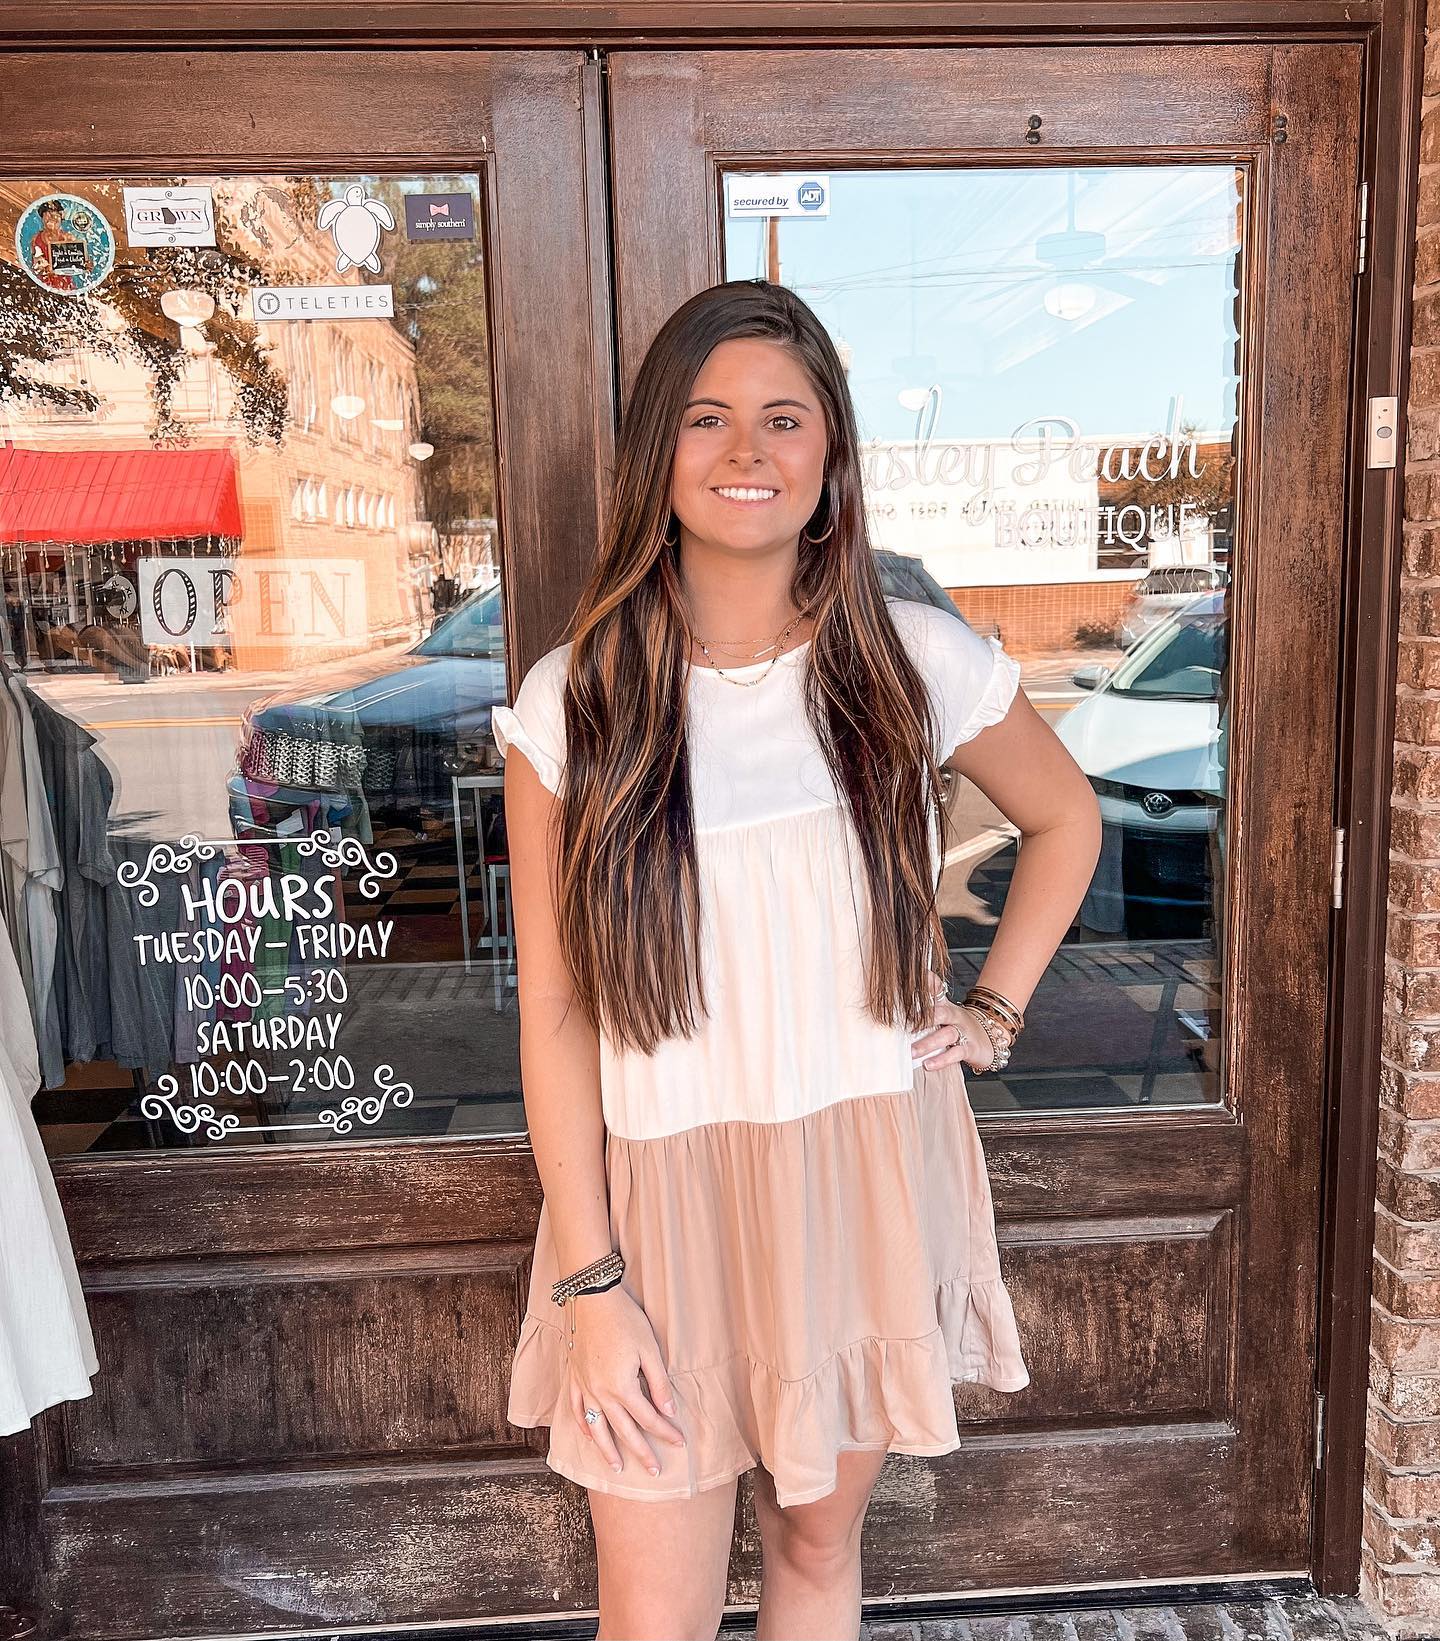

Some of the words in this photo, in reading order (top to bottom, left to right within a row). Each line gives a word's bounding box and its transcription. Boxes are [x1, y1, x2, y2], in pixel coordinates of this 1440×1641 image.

[733, 197, 775, 206] secured
[776, 196, 789, 207] by
[802, 189, 821, 203] ADT
[415, 218, 437, 232] simply
[437, 217, 466, 228] southern
[286, 295, 389, 310] TELETIES
[1008, 394, 1207, 486] Peach
[994, 503, 1197, 552] BOUTIQUE
[152, 568, 351, 637] OPEN
[181, 874, 336, 924] HOURS
[133, 925, 262, 966] TUESDAY
[295, 920, 394, 960] FRIDAY
[196, 1012, 343, 1055] SATURDAY
